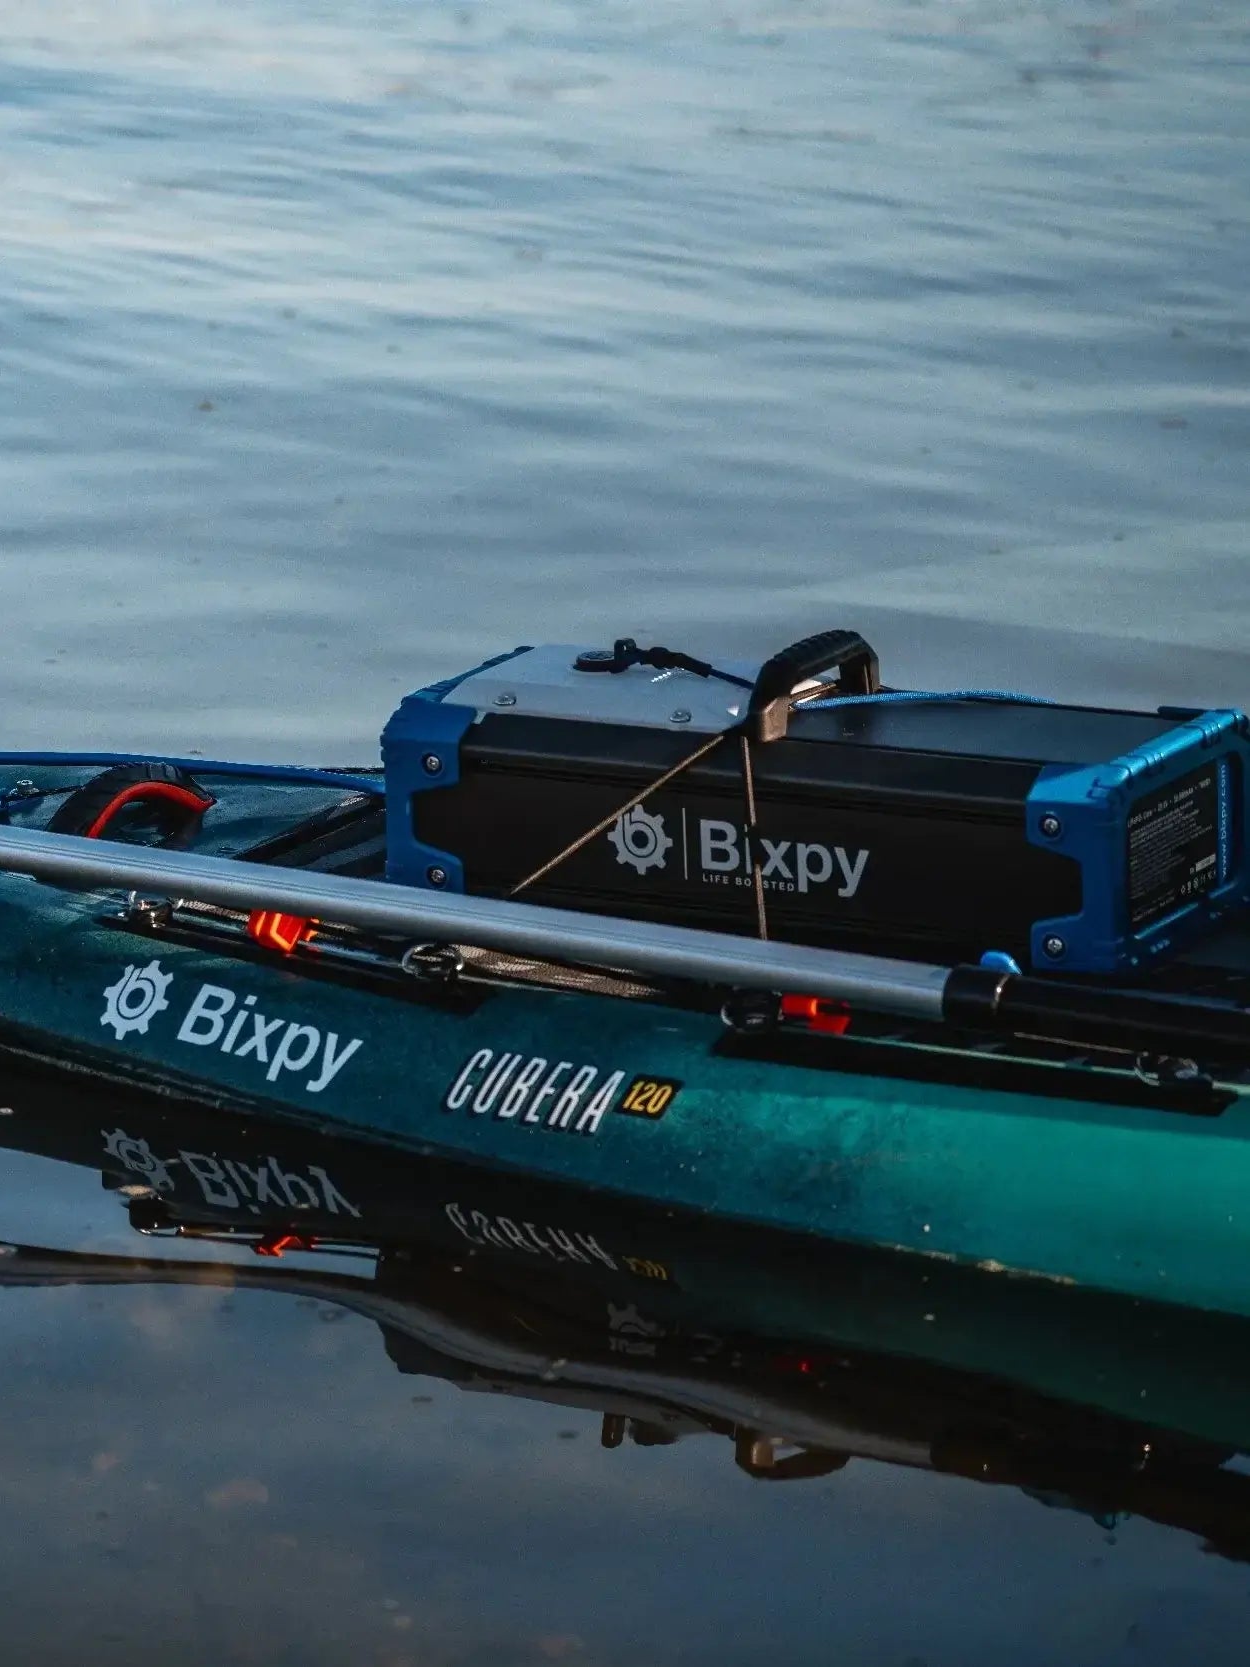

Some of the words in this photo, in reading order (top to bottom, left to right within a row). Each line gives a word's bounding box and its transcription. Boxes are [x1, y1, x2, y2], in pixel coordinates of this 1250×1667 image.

[702, 873, 730, 885] LIFE
[735, 877, 795, 892] BOSTED
[177, 983, 364, 1093] Bixpy
[447, 1049, 626, 1133] CUBERA
[623, 1081, 672, 1114] 120
